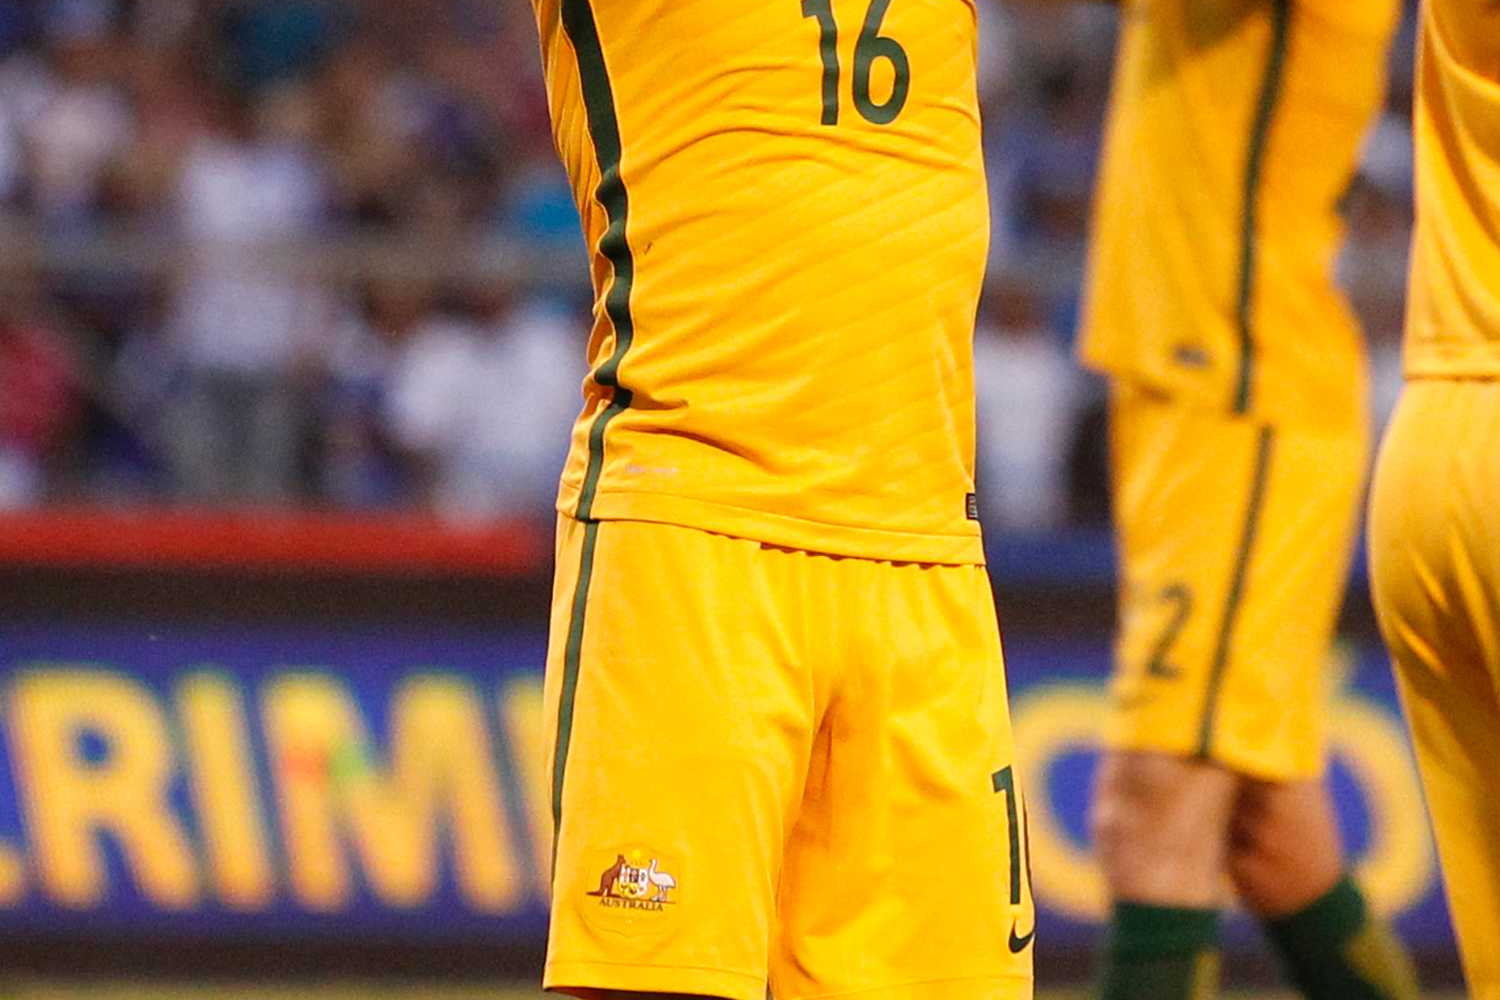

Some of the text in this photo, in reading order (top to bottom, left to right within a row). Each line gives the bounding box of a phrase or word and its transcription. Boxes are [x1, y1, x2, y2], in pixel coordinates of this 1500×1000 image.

[1145, 582, 1194, 678] 2
[0, 664, 556, 914] RIM
[991, 764, 1022, 905] 1
[600, 897, 664, 912] AUSTRALIA
